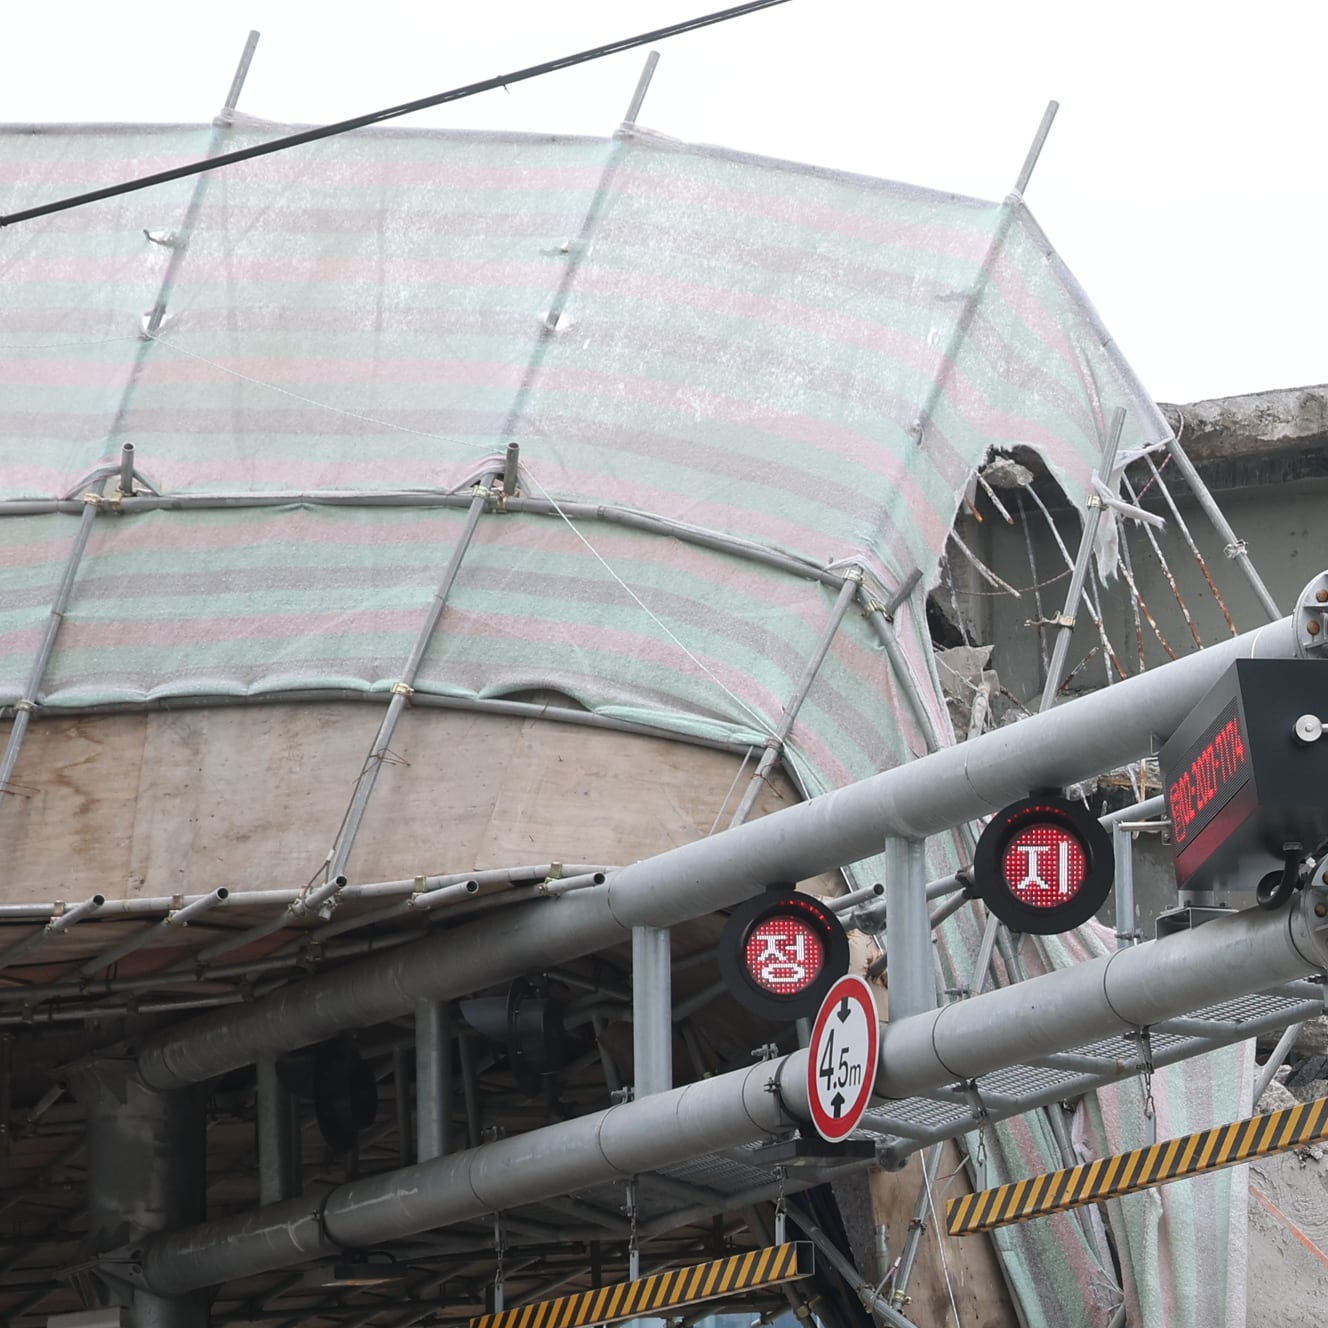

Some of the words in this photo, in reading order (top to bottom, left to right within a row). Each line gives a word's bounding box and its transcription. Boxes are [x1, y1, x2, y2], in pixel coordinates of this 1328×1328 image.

[1017, 841, 1068, 895] 지
[757, 934, 804, 983] 정
[819, 1028, 861, 1091] 4.5m
